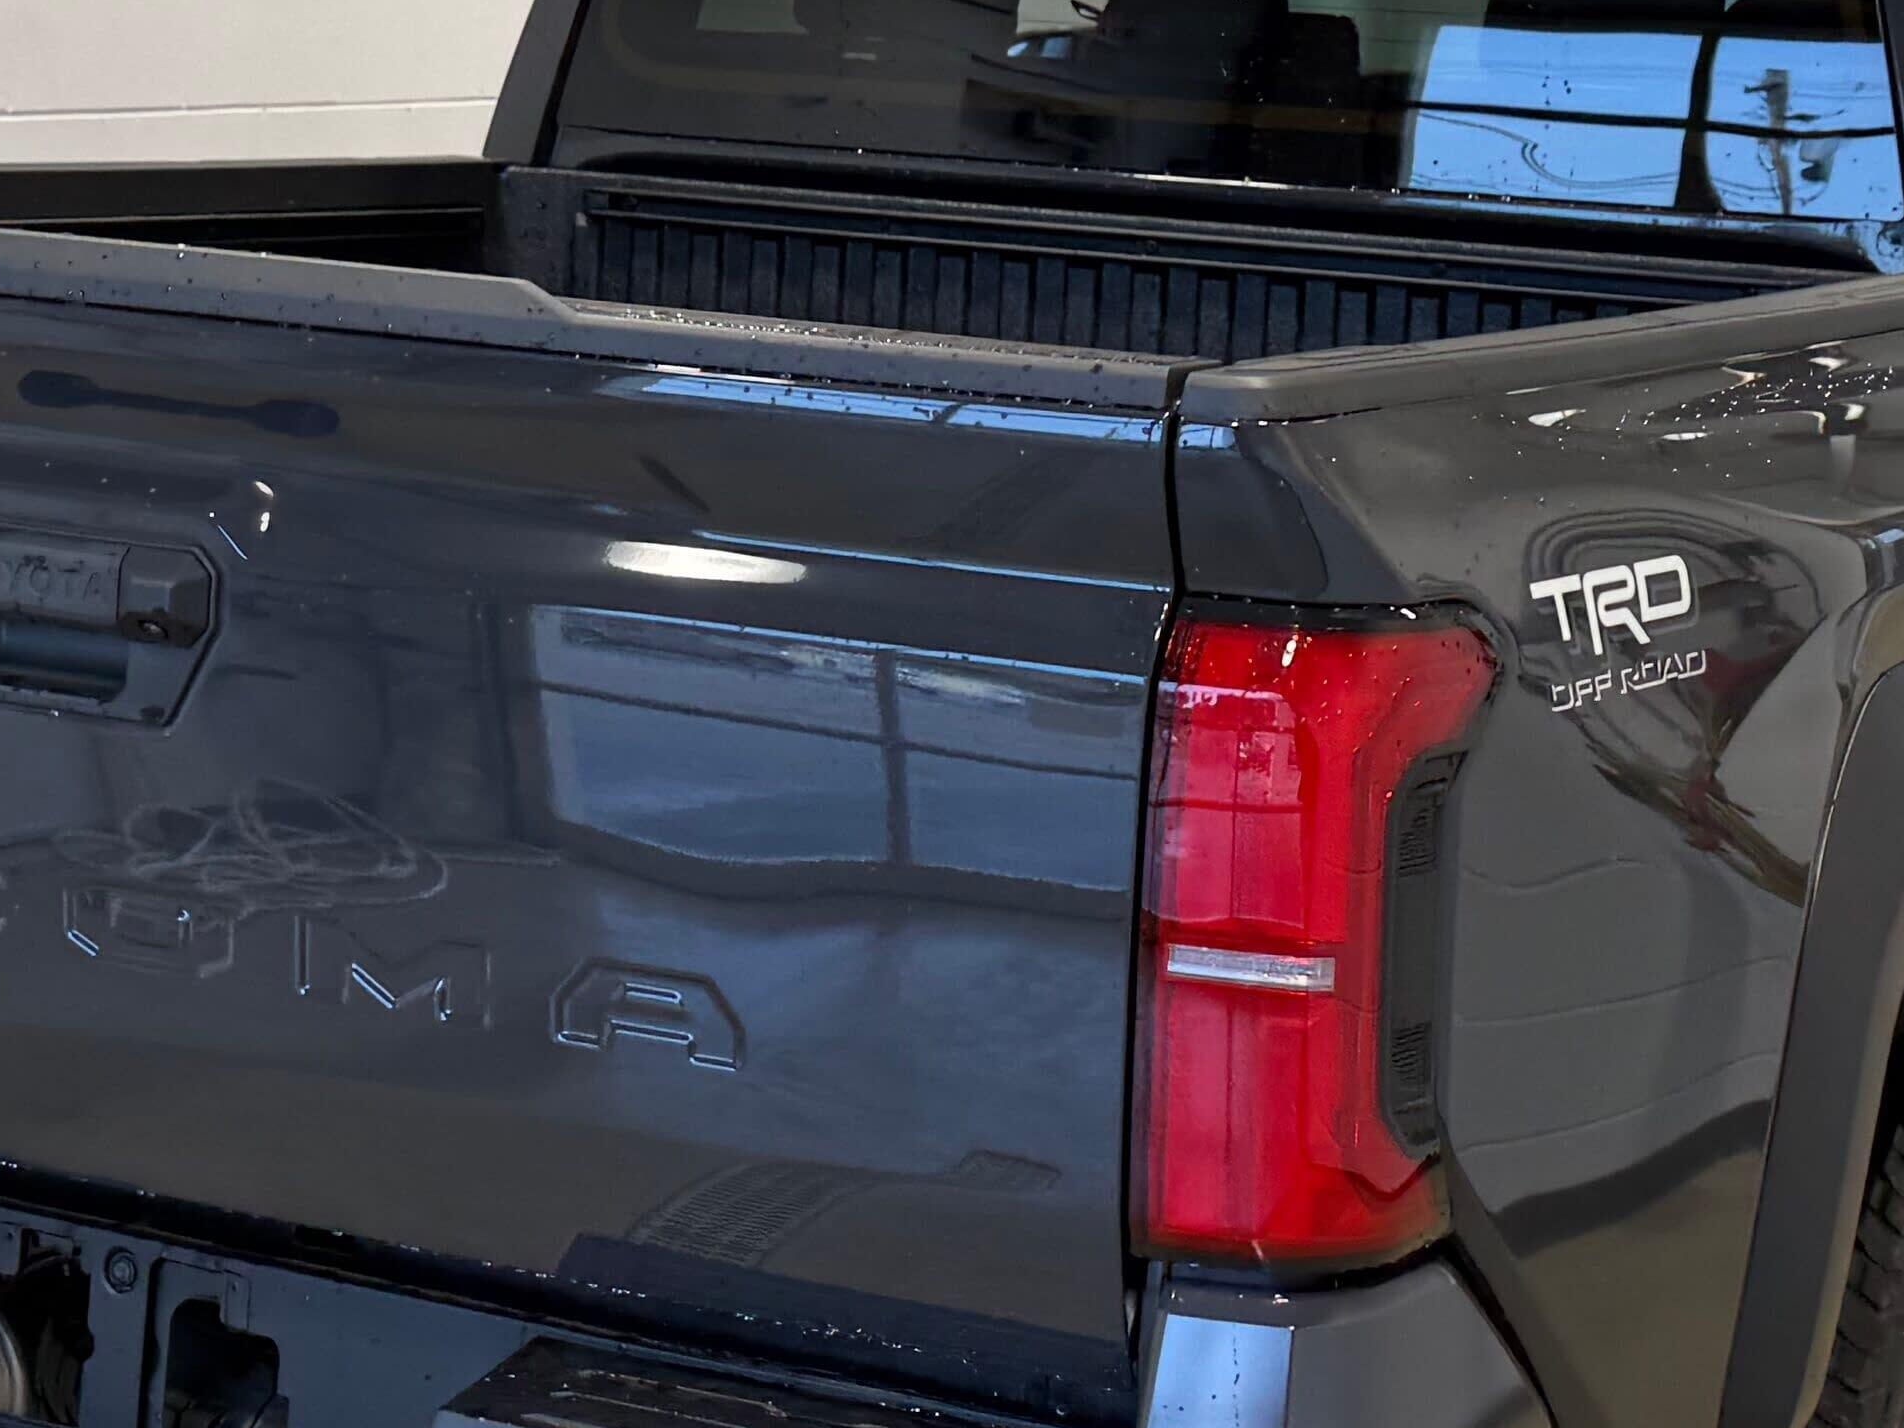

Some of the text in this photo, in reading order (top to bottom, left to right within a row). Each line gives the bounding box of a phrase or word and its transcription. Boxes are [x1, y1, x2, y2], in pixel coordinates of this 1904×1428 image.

[1529, 554, 1692, 655] TRD
[1551, 650, 1707, 712] OFF ROAD
